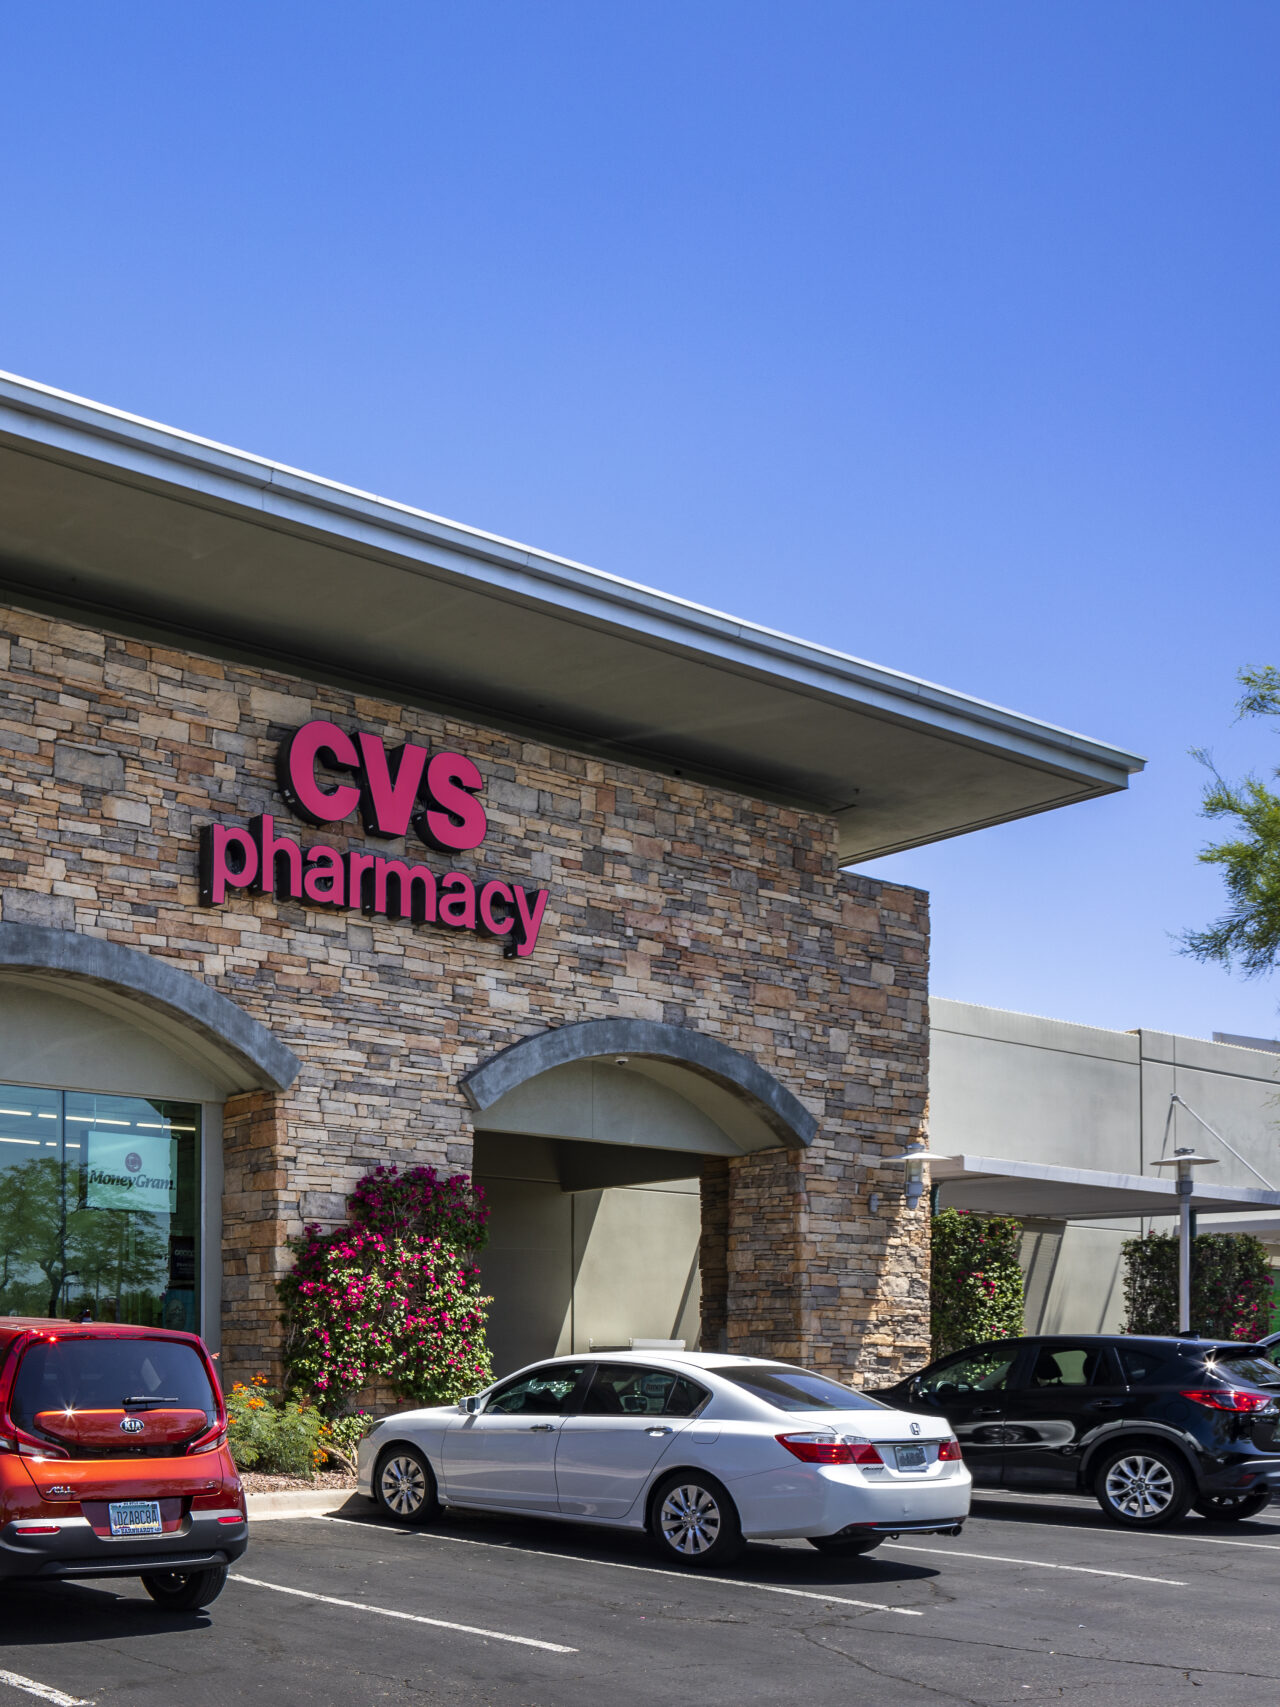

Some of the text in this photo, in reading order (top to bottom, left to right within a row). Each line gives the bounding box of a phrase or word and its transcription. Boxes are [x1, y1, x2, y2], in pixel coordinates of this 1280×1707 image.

[280, 720, 487, 851] CVS
[204, 814, 550, 957] pharmacy
[124, 1420, 141, 1431] KIA
